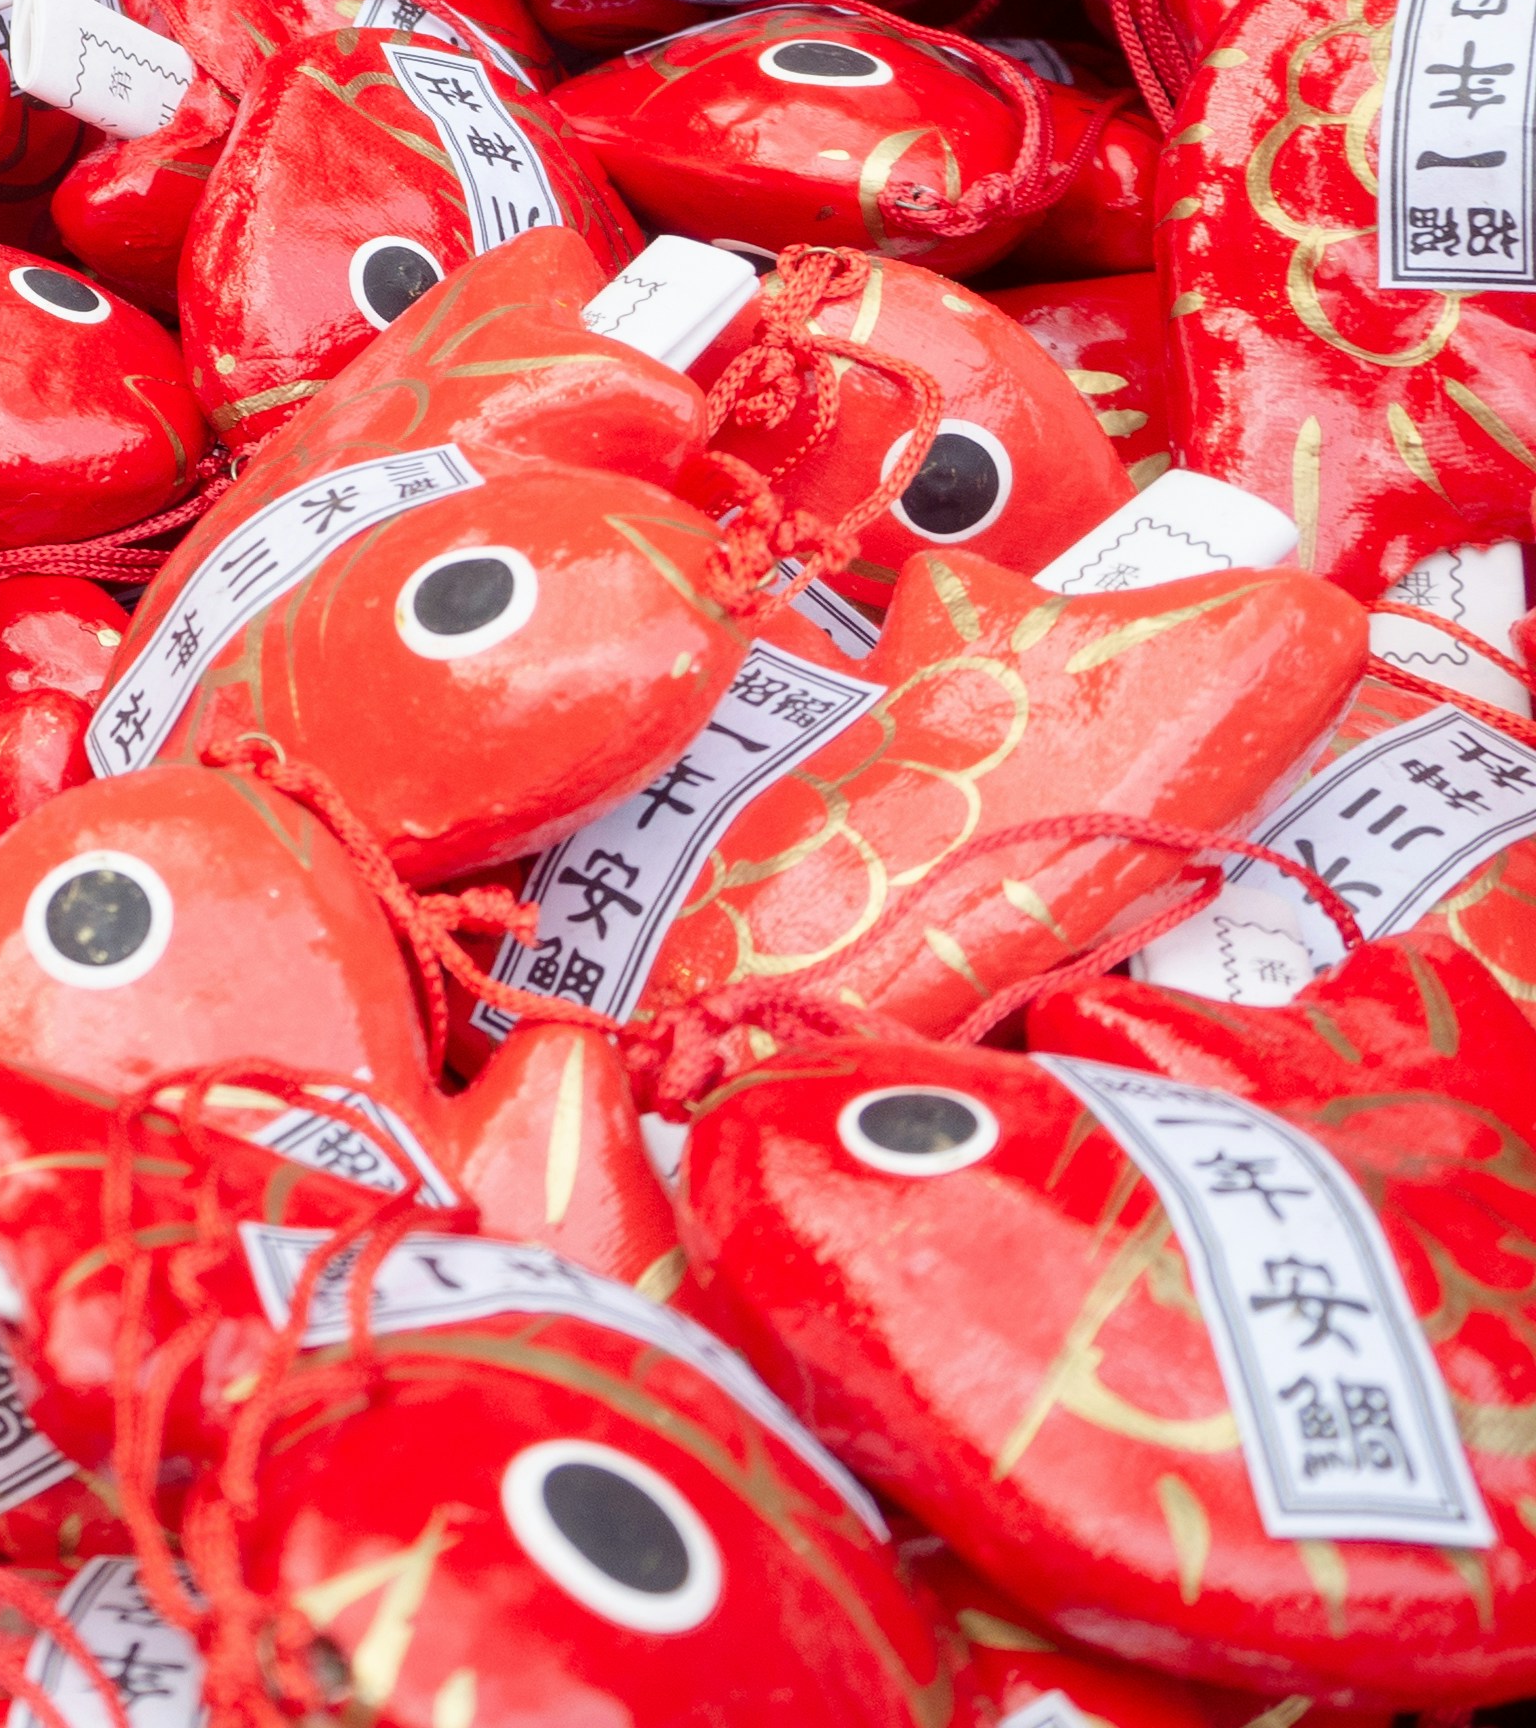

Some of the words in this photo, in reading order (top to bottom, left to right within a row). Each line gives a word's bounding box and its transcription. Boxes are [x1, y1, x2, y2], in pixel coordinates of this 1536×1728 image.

[1408, 205, 1522, 261] 招福
[108, 484, 361, 763] 氷川神社
[727, 668, 835, 731] 招福
[528, 719, 771, 1009] 一年安鯛
[1155, 1115, 1417, 1486] 一年安鯛
